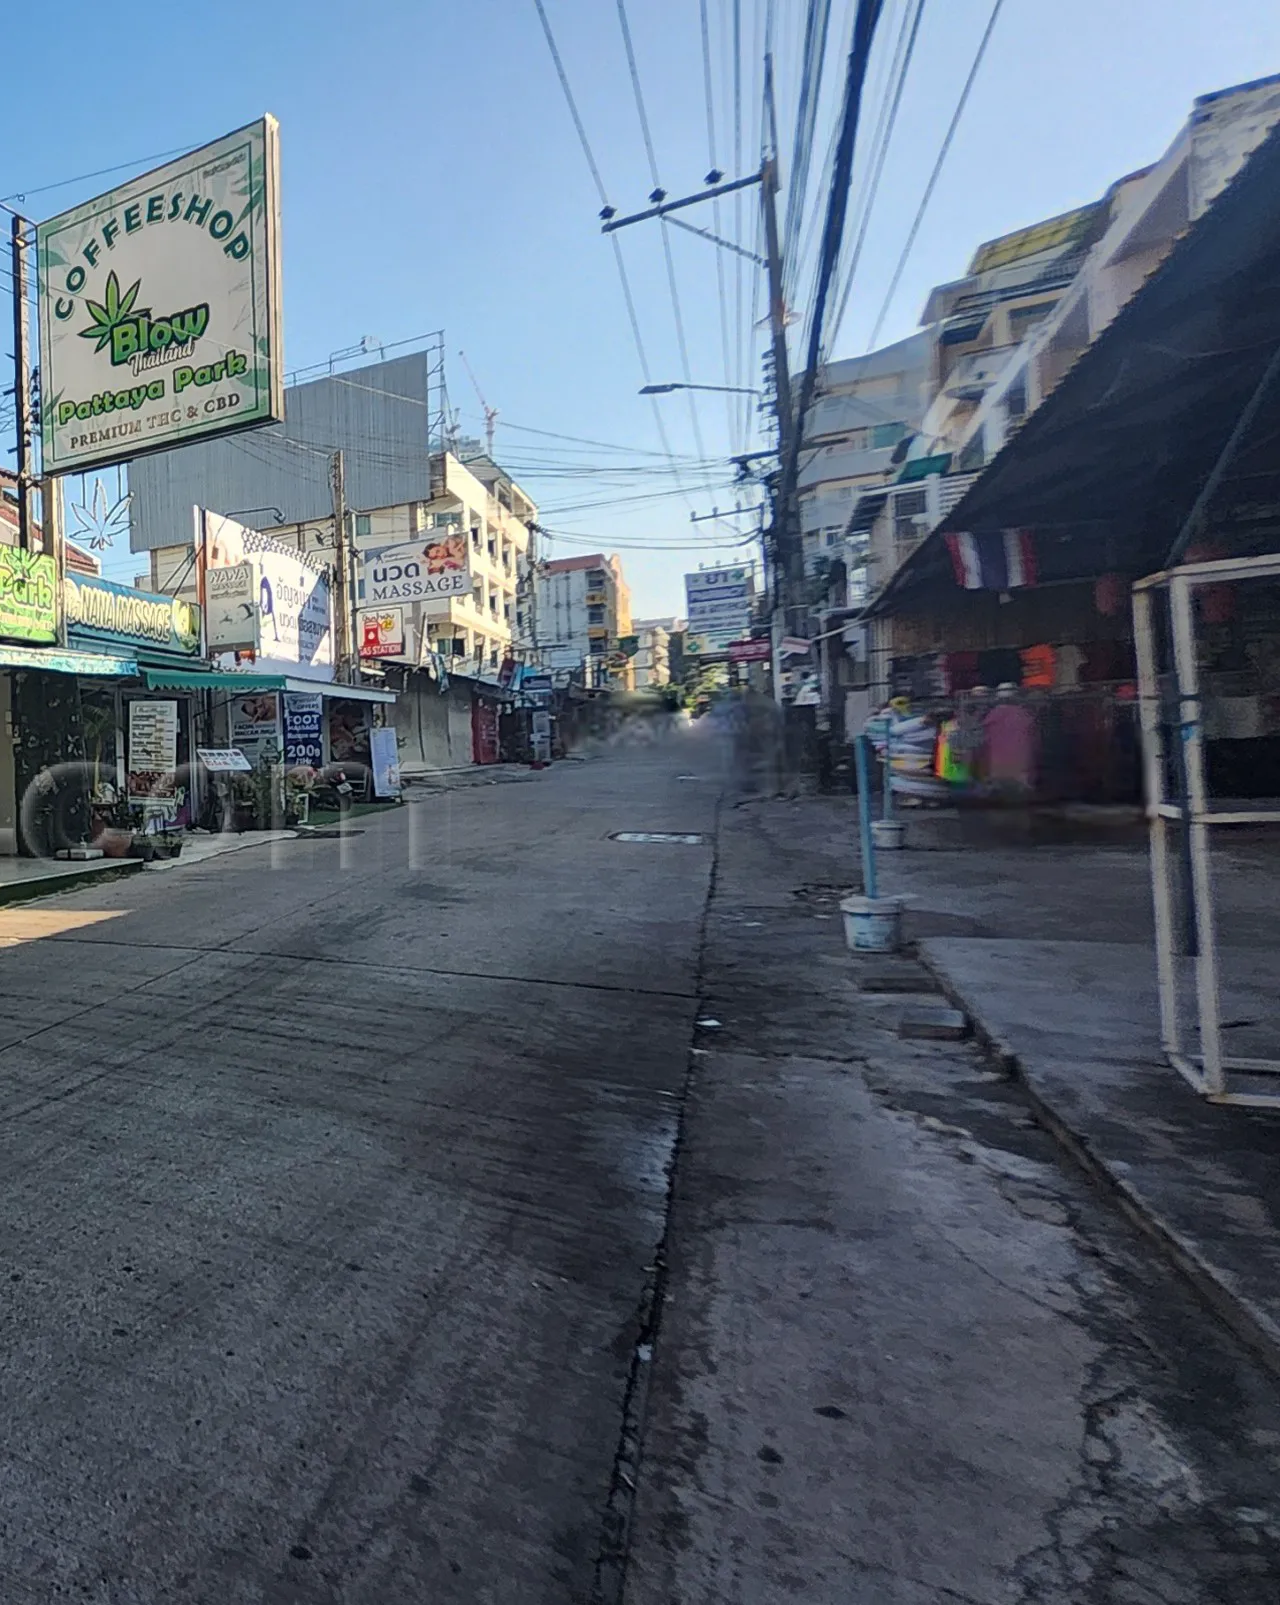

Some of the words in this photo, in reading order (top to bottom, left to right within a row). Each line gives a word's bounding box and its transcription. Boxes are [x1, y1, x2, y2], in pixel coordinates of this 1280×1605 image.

[55, 191, 251, 320] COFFEESHOP
[111, 302, 210, 366] Blow
[128, 336, 196, 377] Thailand
[59, 379, 165, 425] Pattaya
[173, 350, 248, 393] Park
[70, 419, 142, 449] PREMIUM
[147, 409, 182, 429] THC
[186, 406, 199, 420] &
[204, 393, 241, 414] CBD
[210, 567, 249, 584] NANA
[372, 575, 464, 601] MASSAGE
[373, 562, 421, 583] นวด
[81, 584, 115, 630] NANA
[116, 594, 171, 643] MASSAGE
[287, 714, 320, 725] FOOT
